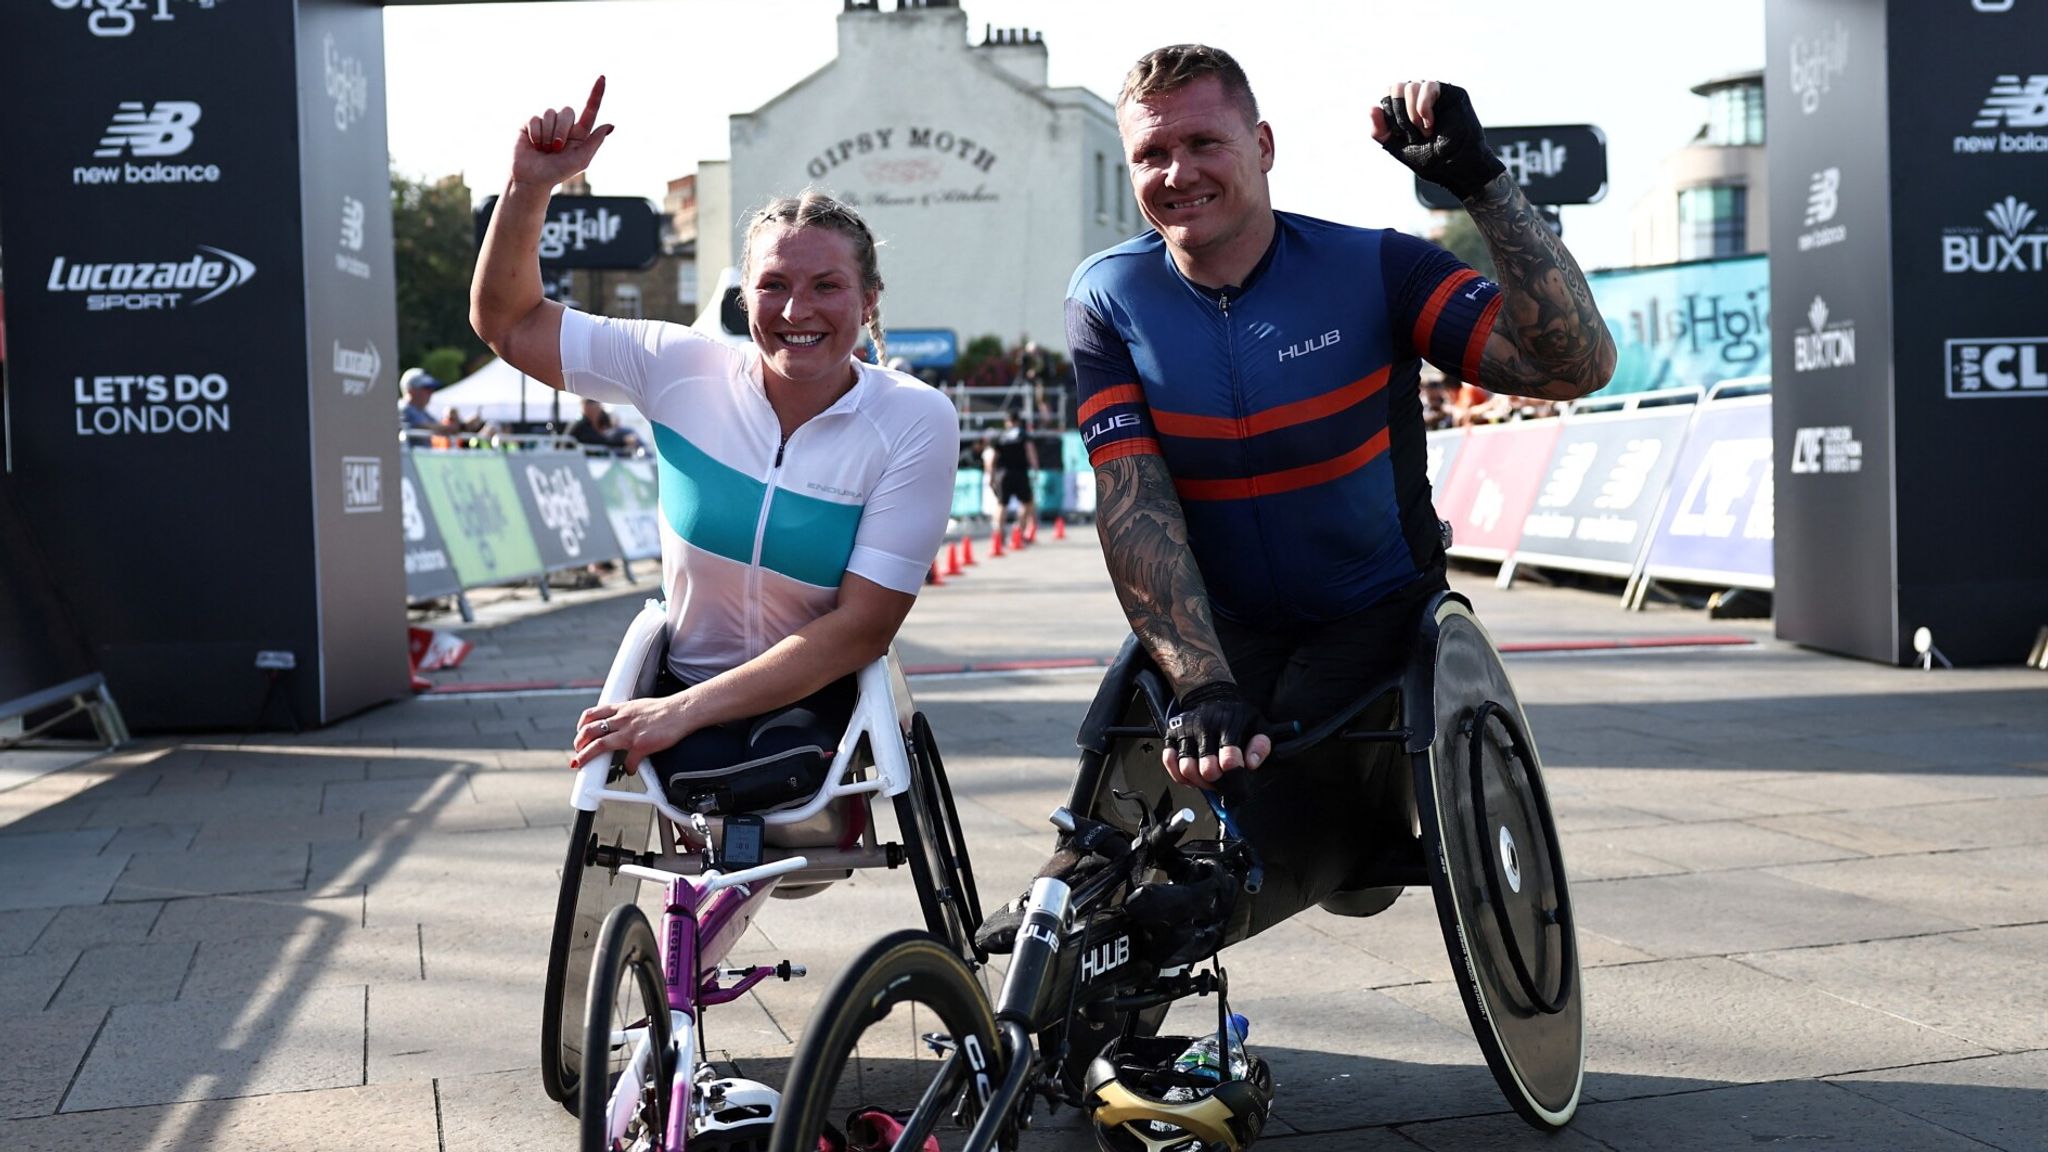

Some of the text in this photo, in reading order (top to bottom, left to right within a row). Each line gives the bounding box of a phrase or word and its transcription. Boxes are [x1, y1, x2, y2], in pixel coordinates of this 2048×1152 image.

[806, 127, 998, 179] GIPSY MOTH
[1502, 138, 1567, 186] Half
[1953, 136, 1998, 153] new
[73, 161, 221, 184] new balance
[539, 208, 621, 258] gHalf
[1943, 234, 2048, 273] BUXT
[47, 254, 224, 292] Lucozade
[86, 293, 182, 311] SPORT
[1278, 329, 1341, 362] HUUB
[1794, 327, 1855, 372] BUXTON
[74, 373, 228, 404] LET'S DO
[76, 403, 230, 435] LONDON
[1017, 924, 1060, 953] UUB
[1081, 935, 1130, 982] HUUB
